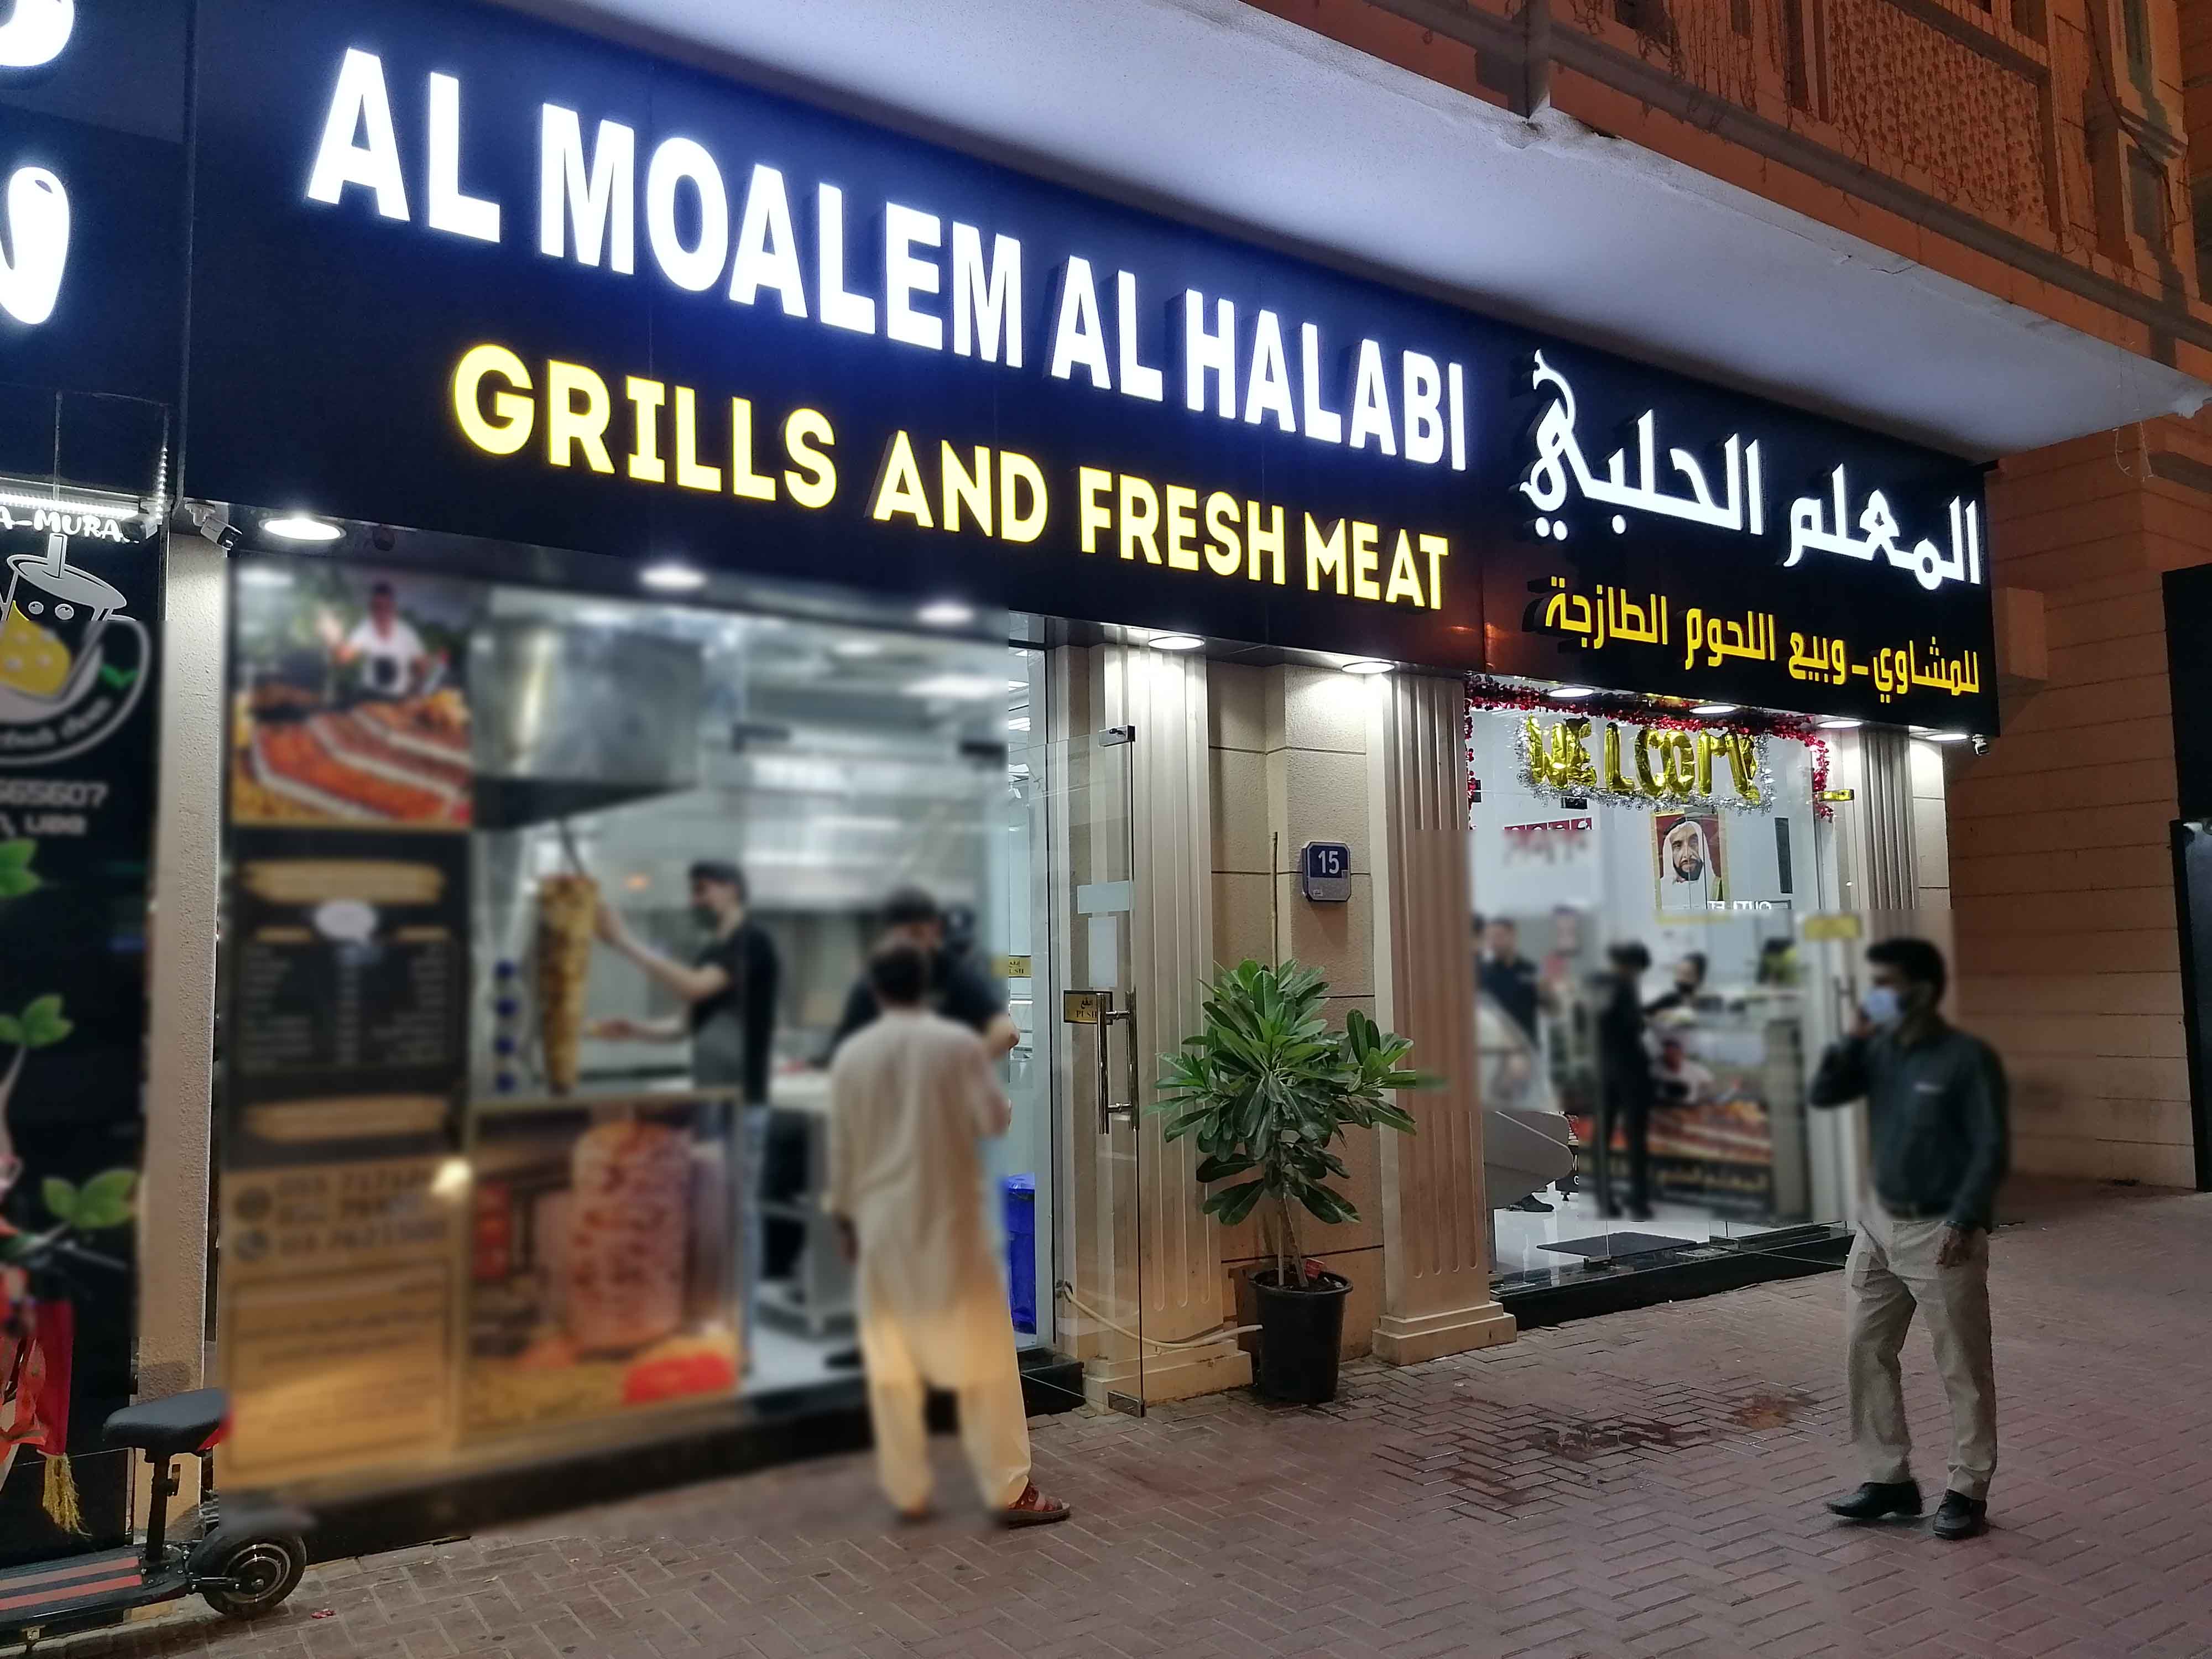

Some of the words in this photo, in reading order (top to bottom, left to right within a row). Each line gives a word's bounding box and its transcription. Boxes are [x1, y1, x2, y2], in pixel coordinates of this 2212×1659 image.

[307, 48, 500, 243] AL
[541, 103, 1022, 368] MOALEM
[1051, 255, 1163, 402] AL
[1185, 288, 1466, 471] HALABI
[453, 344, 837, 509] GRILLS
[873, 430, 1048, 542] AND
[1079, 466, 1286, 586] FRESH
[1304, 512, 1449, 610] MEAT
[1519, 349, 1763, 541] الحلبي
[1783, 463, 1980, 591] المعلم
[1545, 576, 1668, 650] الطازجة
[1685, 607, 1776, 670] اللحوم
[1318, 851, 1339, 874] 15
